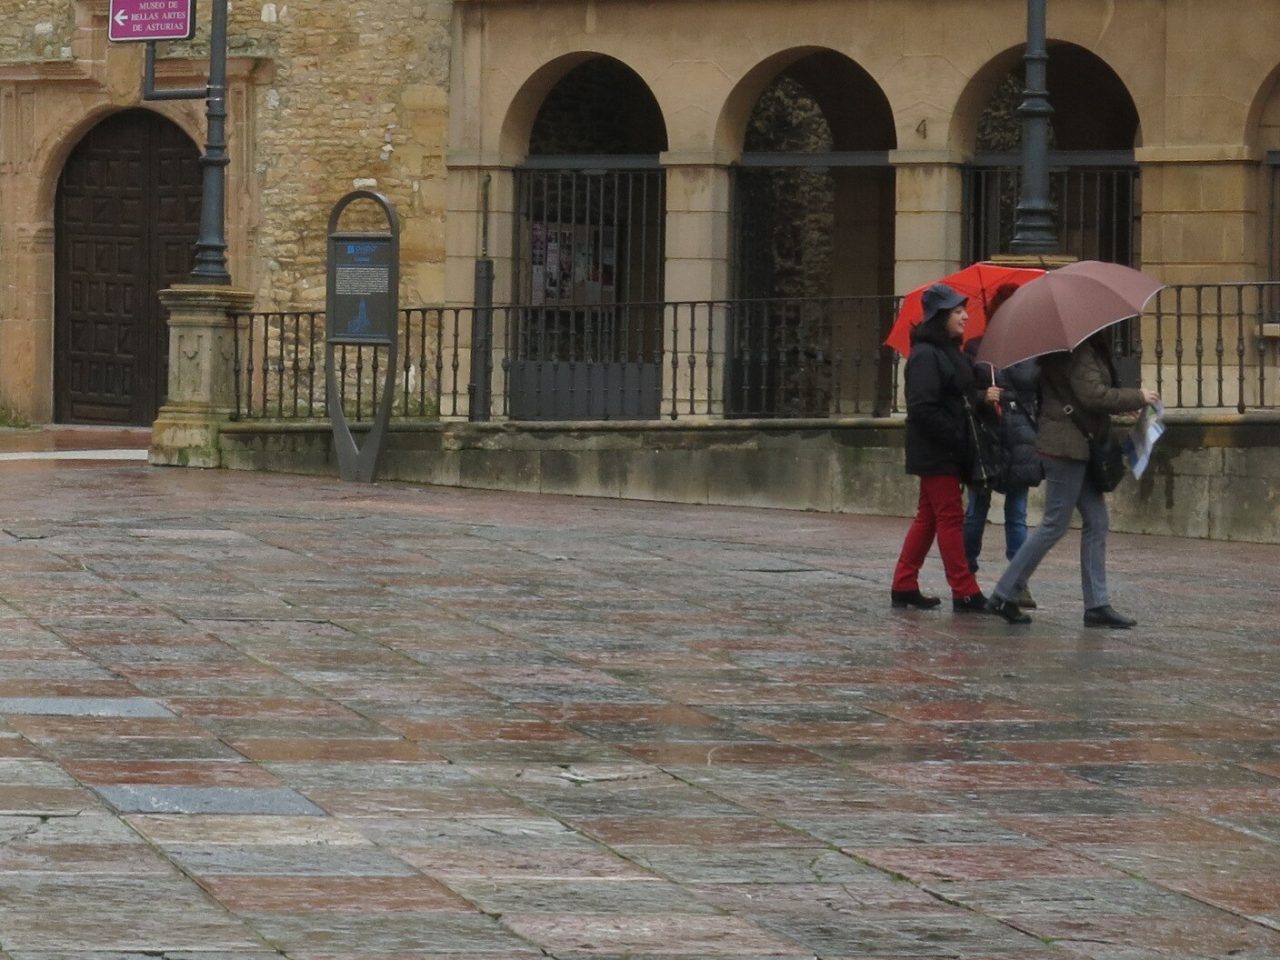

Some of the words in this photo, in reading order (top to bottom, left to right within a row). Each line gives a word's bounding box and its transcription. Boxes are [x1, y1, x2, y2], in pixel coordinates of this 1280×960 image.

[139, 2, 165, 10] MUSEO
[131, 13, 158, 21] BELLAS
[161, 12, 185, 20] ARTES
[132, 24, 142, 32] DE
[146, 23, 183, 31] ASTURIAS
[915, 119, 927, 139] 4
